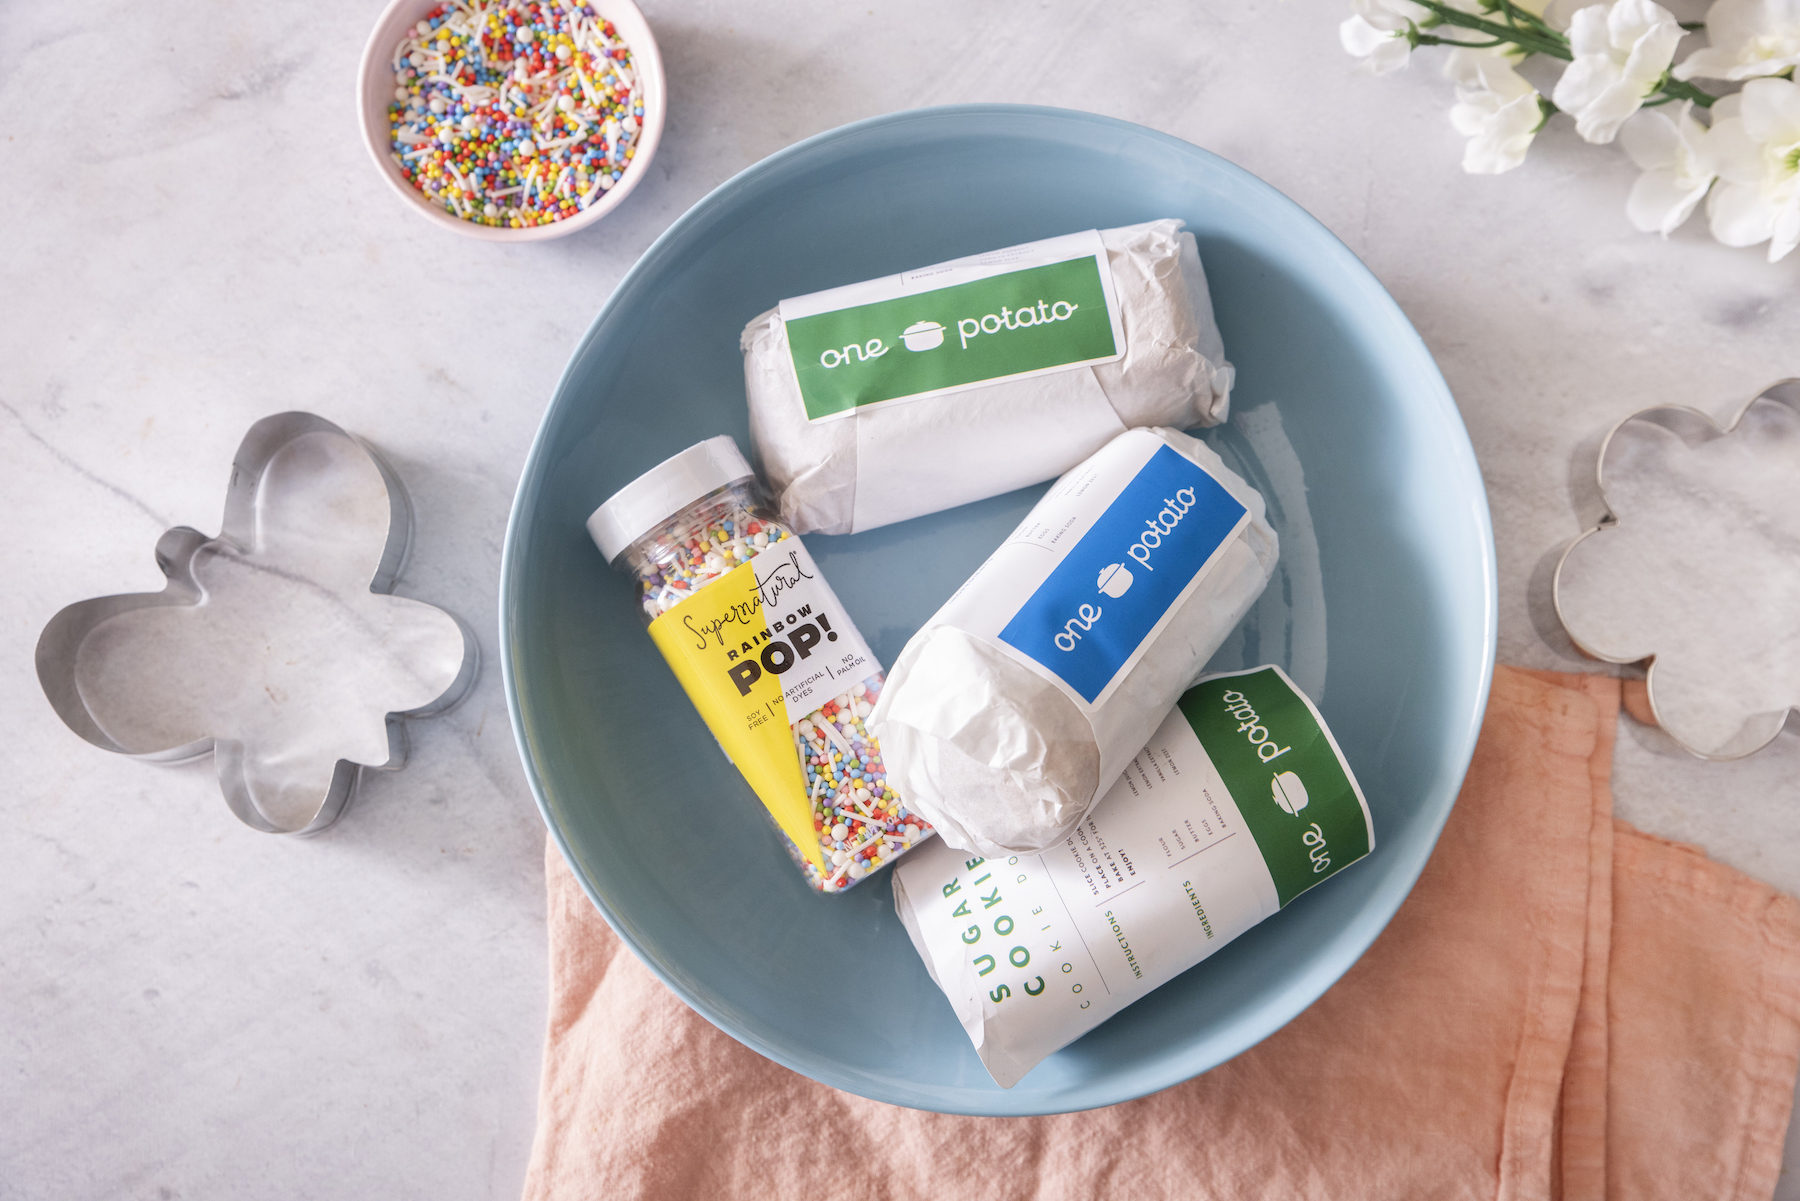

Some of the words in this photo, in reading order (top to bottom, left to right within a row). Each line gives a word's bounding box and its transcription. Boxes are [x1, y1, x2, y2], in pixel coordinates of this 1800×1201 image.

[821, 337, 889, 369] one
[957, 299, 1079, 349] potato
[1054, 603, 1102, 652] one
[1127, 486, 1197, 572] potato
[683, 551, 814, 650] Supernatural
[726, 603, 813, 661] RAINBOW
[727, 612, 838, 697] POP!
[836, 662, 855, 677] PALM
[854, 656, 866, 666] OIL
[841, 653, 854, 664] NO
[772, 695, 785, 705] NO
[785, 671, 825, 698] ARTIFICIAL
[792, 686, 814, 703] DYES
[746, 709, 761, 722] SOY
[748, 714, 769, 731] FREE
[1222, 689, 1292, 764] potato
[1202, 788, 1214, 805] SODA
[1088, 821, 1098, 835] FOR
[1201, 819, 1214, 836] EGGS
[1211, 805, 1227, 829] BAKING
[1171, 829, 1186, 850] SUGAR
[1184, 819, 1200, 843] BUTTER
[1070, 846, 1087, 873] COOKIE
[1089, 852, 1098, 864] ON
[1103, 851, 1112, 861] AT
[1302, 822, 1332, 874] one
[1109, 861, 1124, 883] BAKE
[1118, 848, 1136, 876] ENJOY!
[1084, 873, 1099, 895] SLICE
[1095, 864, 1112, 889] PLACE
[1183, 880, 1214, 940] INGREDIENTS
[965, 856, 1046, 997] COOKIE
[942, 877, 1011, 1004] SUGAR
[1104, 910, 1143, 980] INSTRUCTIONS
[1031, 905, 1091, 1009] COOKIE
